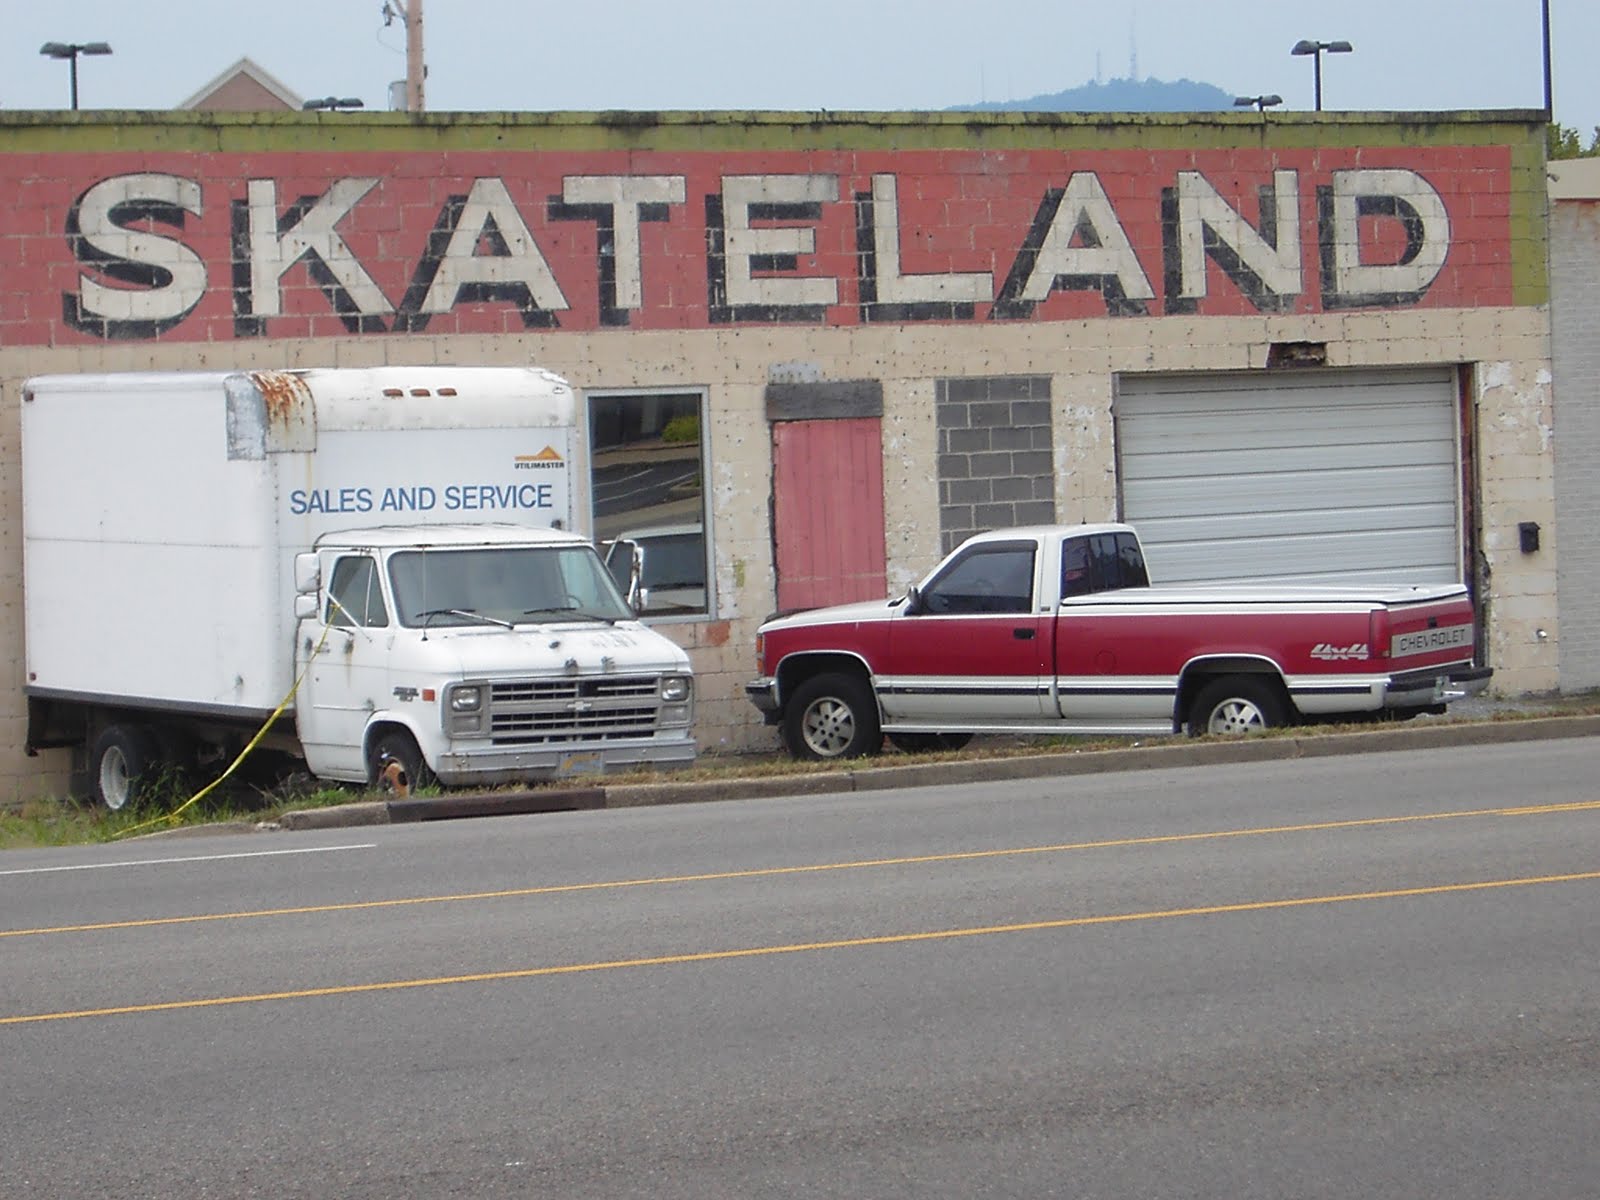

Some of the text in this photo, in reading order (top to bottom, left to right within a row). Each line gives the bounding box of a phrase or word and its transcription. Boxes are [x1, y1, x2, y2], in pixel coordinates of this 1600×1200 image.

[65, 167, 1452, 337] SKATELAND
[514, 462, 565, 470] UTILIMASTER
[290, 484, 553, 515] SALES AND SERVICE
[1400, 628, 1466, 651] CHEVROLET
